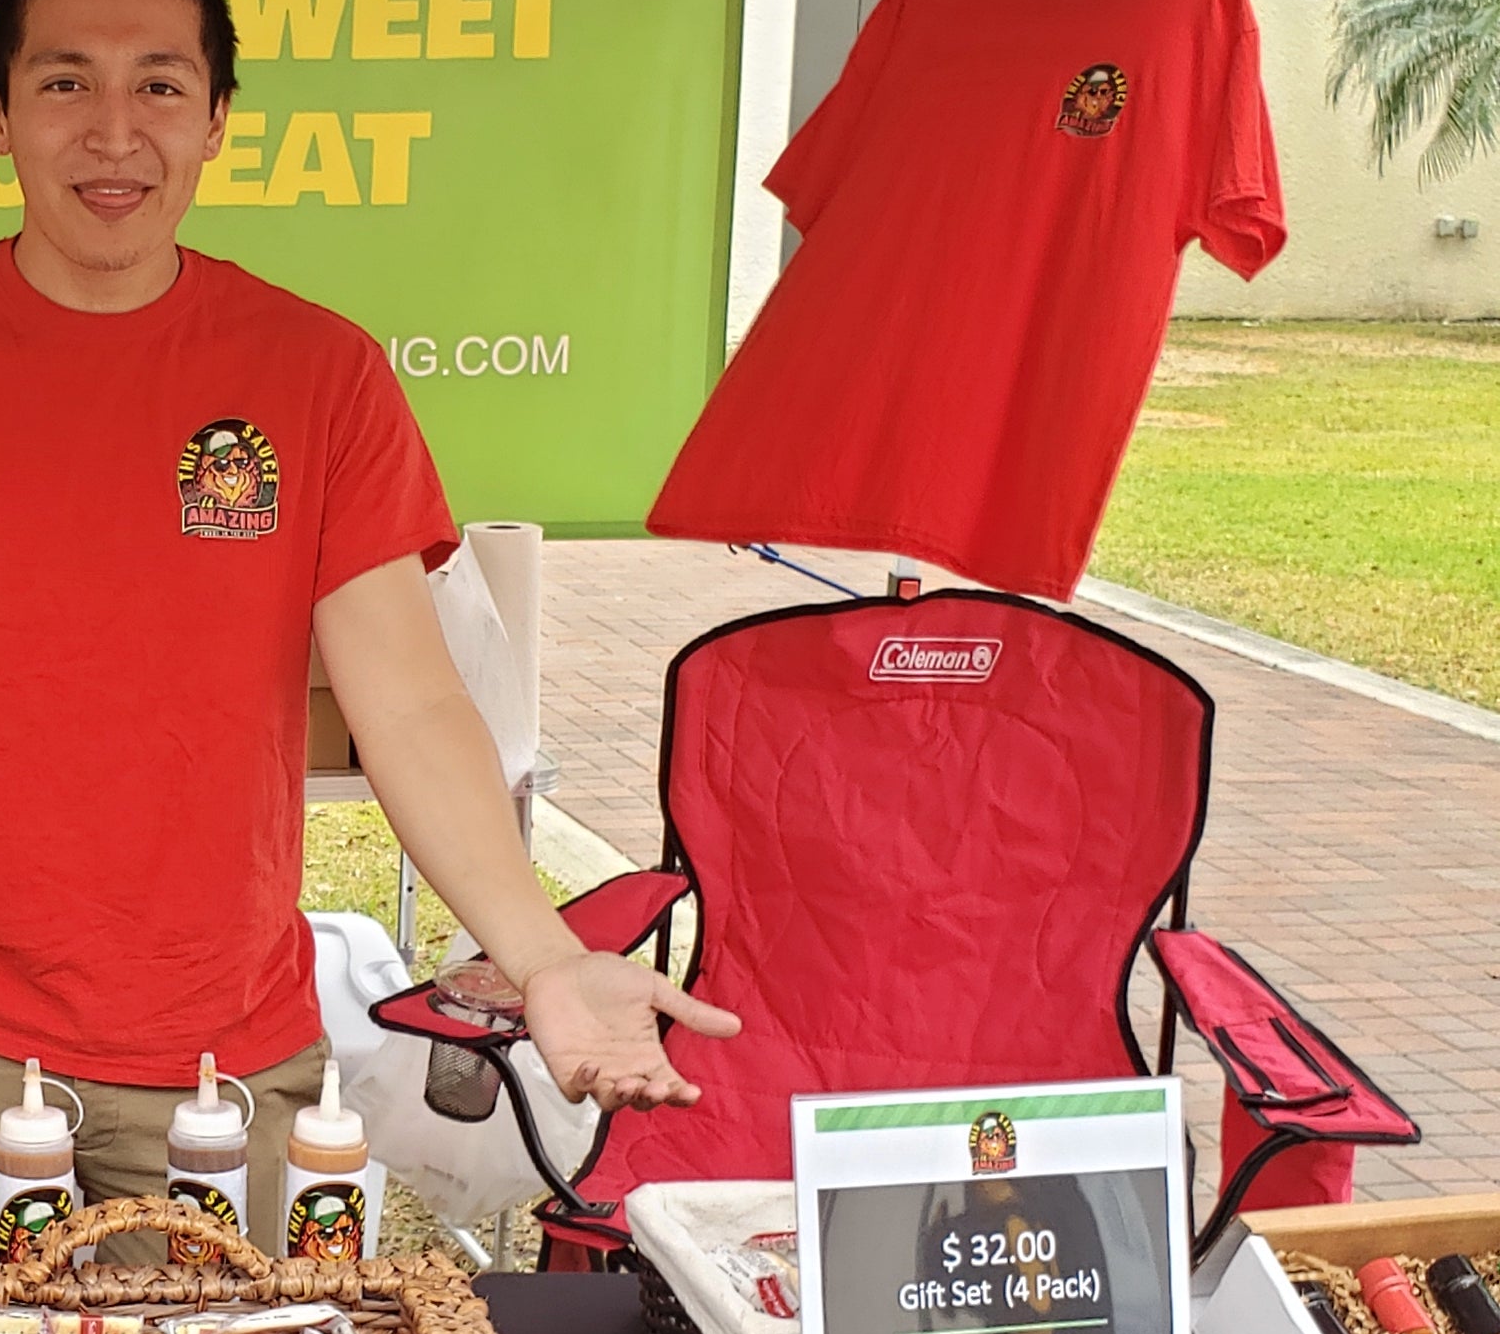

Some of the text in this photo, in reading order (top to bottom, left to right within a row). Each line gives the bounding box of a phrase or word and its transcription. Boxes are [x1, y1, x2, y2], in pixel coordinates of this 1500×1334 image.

[196, 112, 432, 207] EAT
[179, 424, 277, 483] THIS SAUCE
[186, 508, 273, 530] AMAZING
[882, 642, 971, 670] Coleman
[205, 1190, 236, 1223] SAU
[288, 1201, 307, 1244] THIS
[942, 1229, 1056, 1273] $ 32.00
[899, 1268, 1100, 1310] Gift Set (4 Pack)
